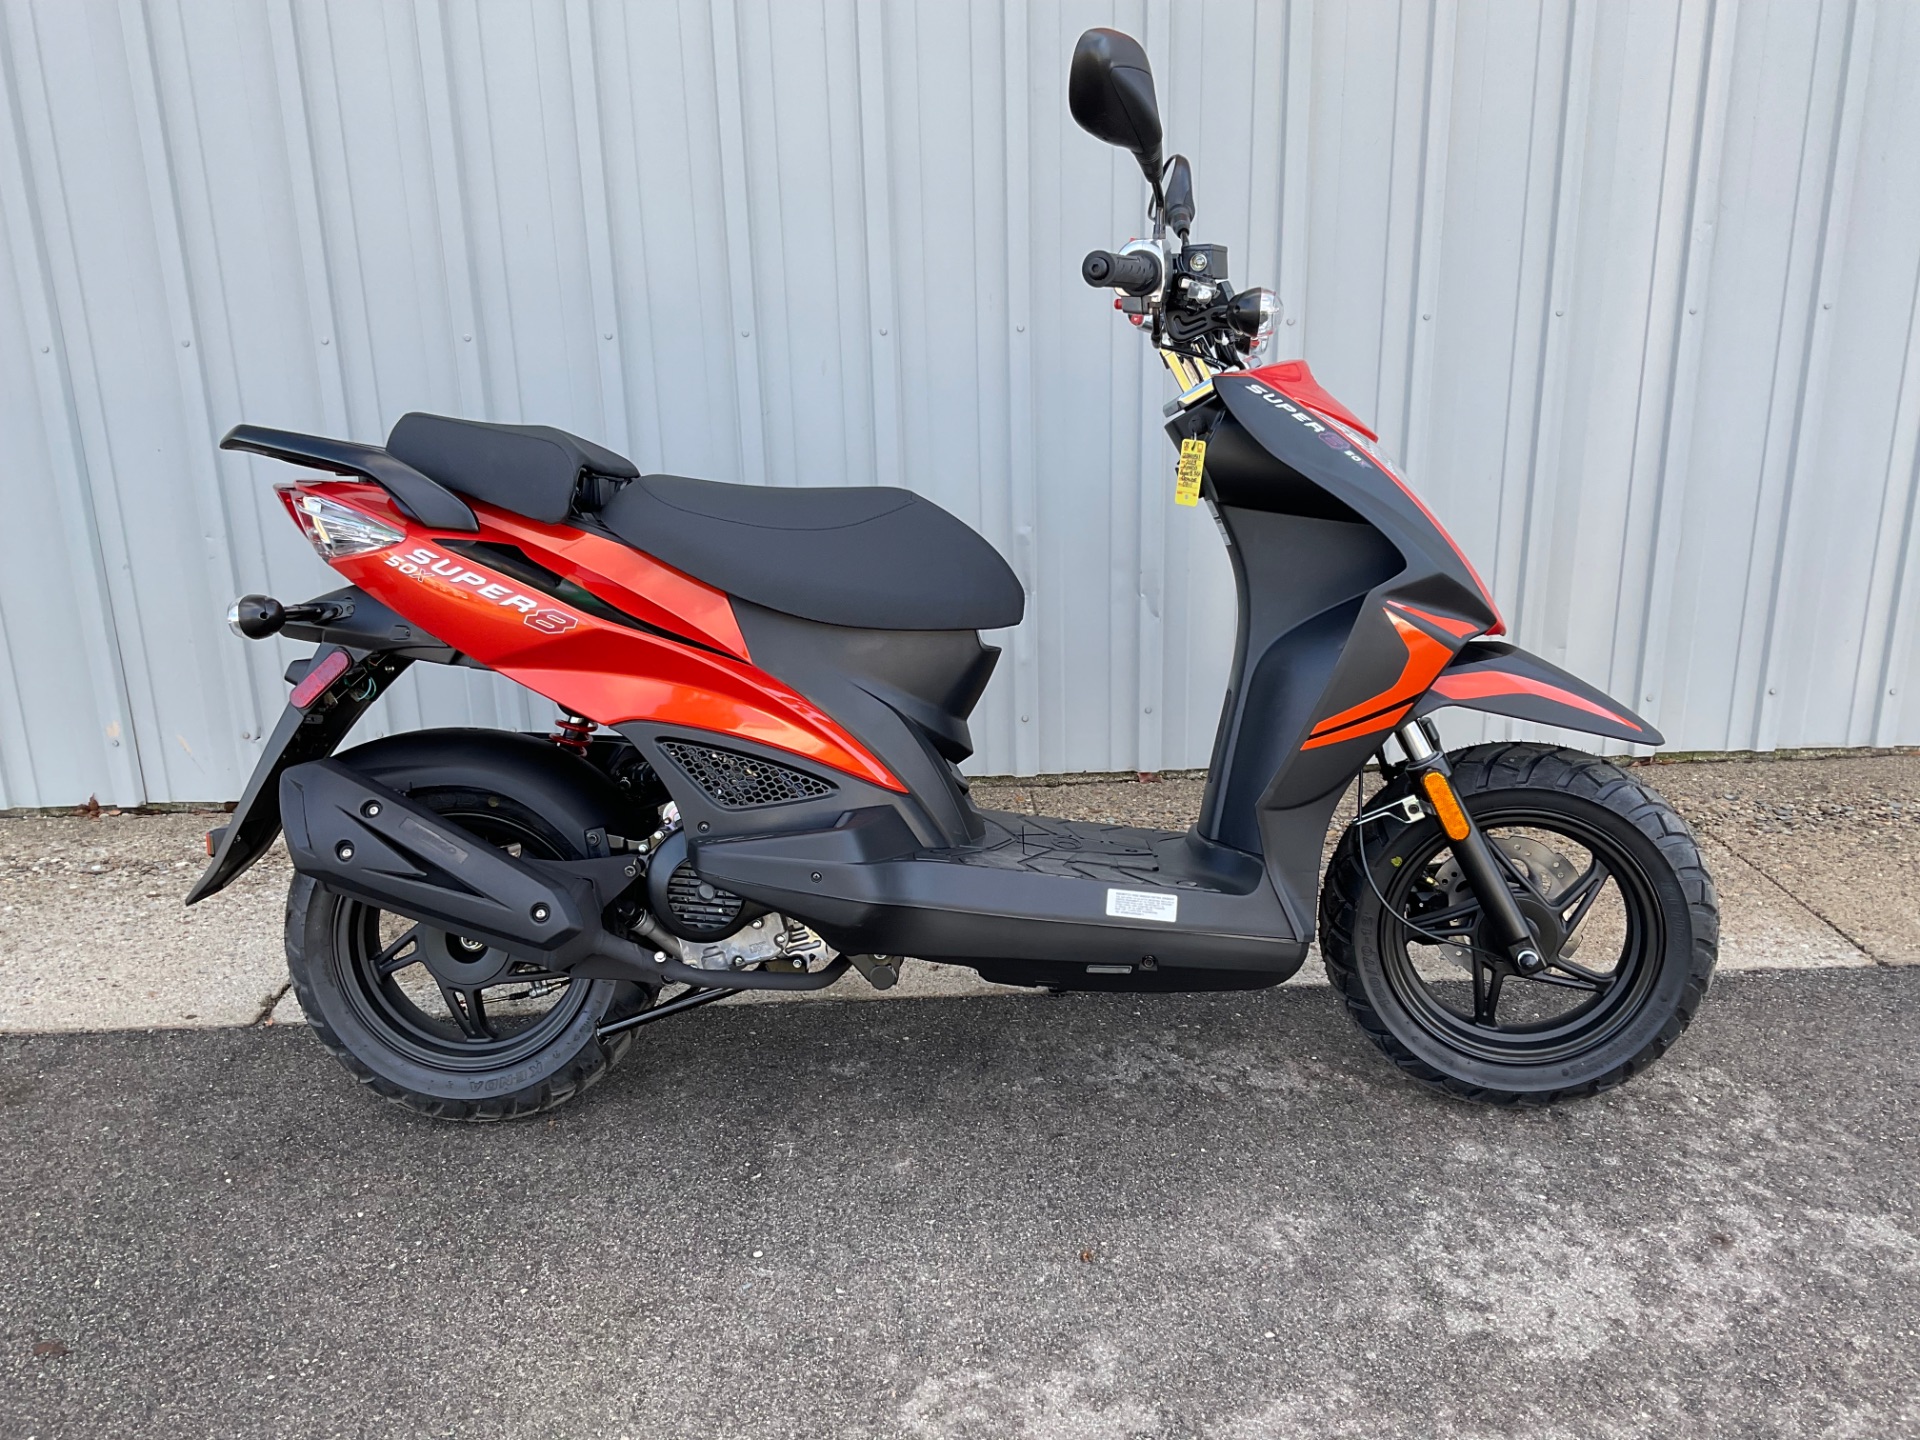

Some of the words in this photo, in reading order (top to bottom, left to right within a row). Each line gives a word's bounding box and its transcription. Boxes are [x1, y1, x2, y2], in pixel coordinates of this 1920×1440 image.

[1245, 384, 1325, 432] SUPER
[384, 555, 435, 583] 50X
[404, 548, 538, 613] SUPER
[523, 608, 579, 634] 8
[469, 1061, 544, 1092] KENDA
